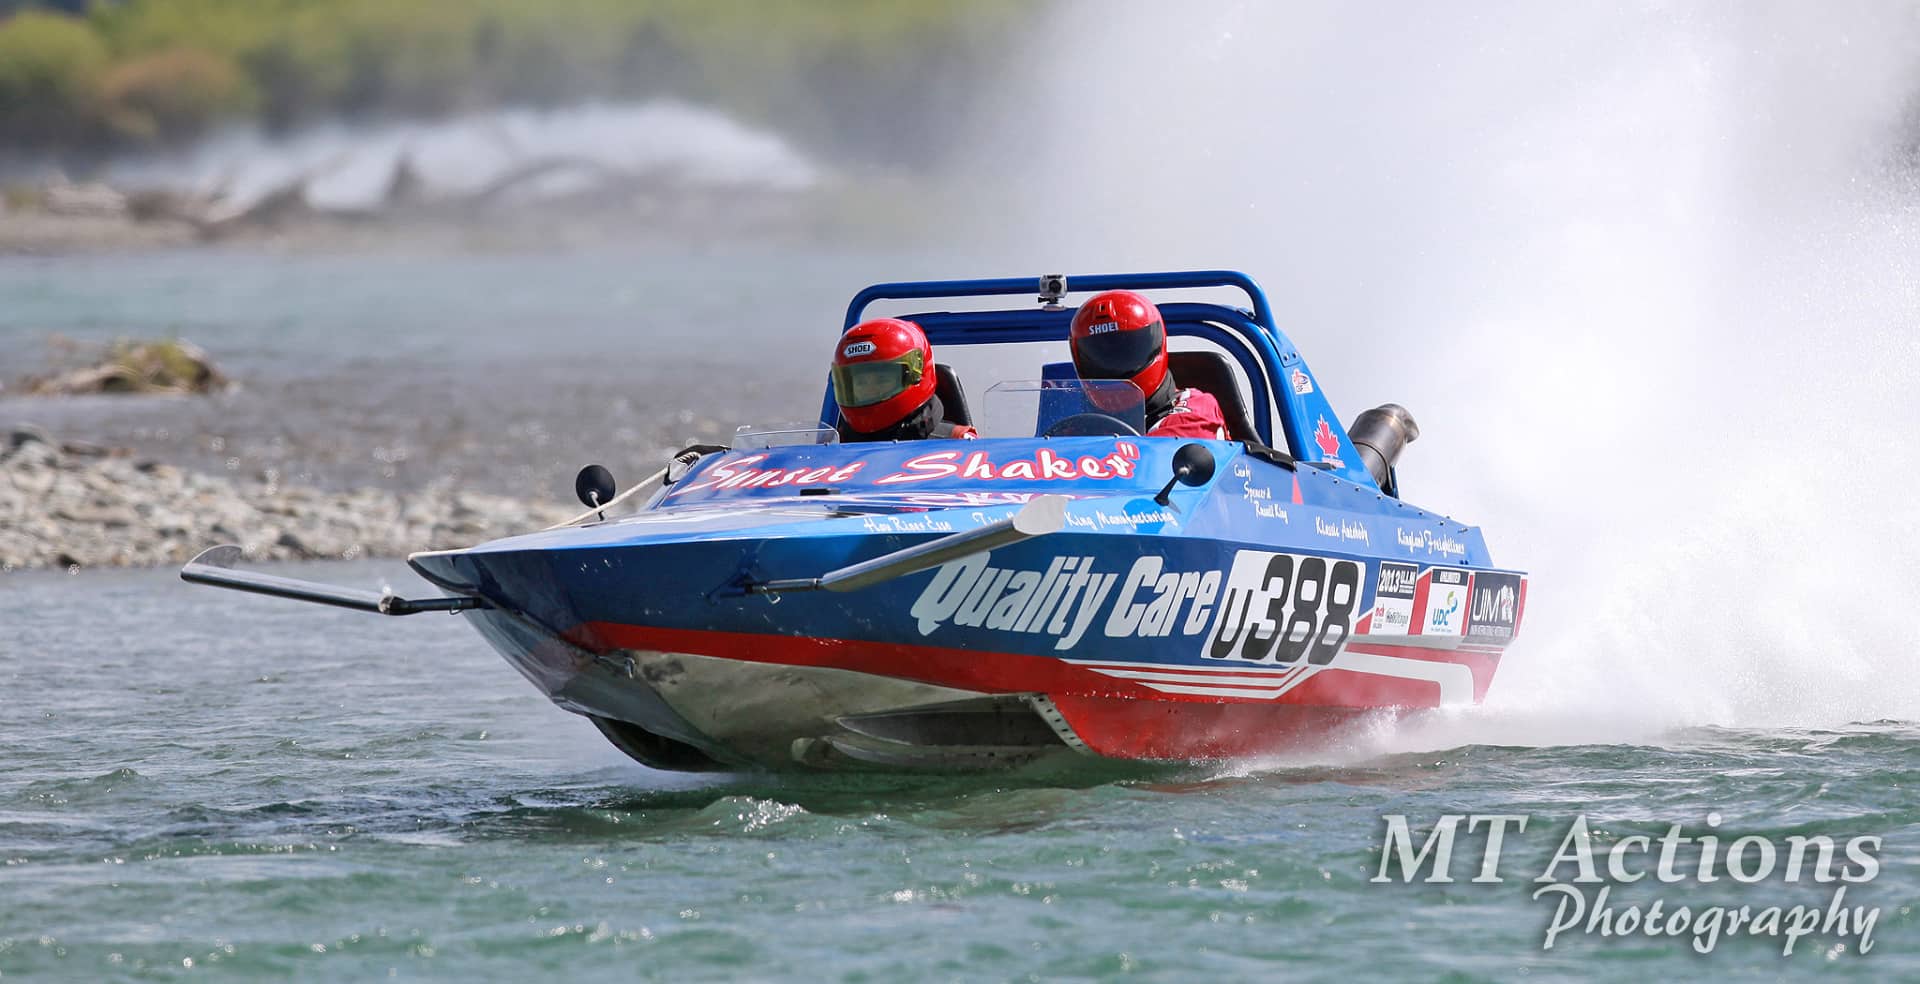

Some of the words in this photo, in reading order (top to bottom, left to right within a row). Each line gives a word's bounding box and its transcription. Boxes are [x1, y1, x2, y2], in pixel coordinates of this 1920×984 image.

[1088, 321, 1119, 335] SHOEI
[847, 344, 871, 355] SHOEI
[1063, 511, 1098, 531] King
[1378, 568, 1401, 594] 2013
[910, 551, 1119, 650] Quality
[1104, 555, 1222, 638] Care
[1210, 554, 1360, 666] U388
[1472, 587, 1501, 623] UIM
[1432, 607, 1451, 626] UDC
